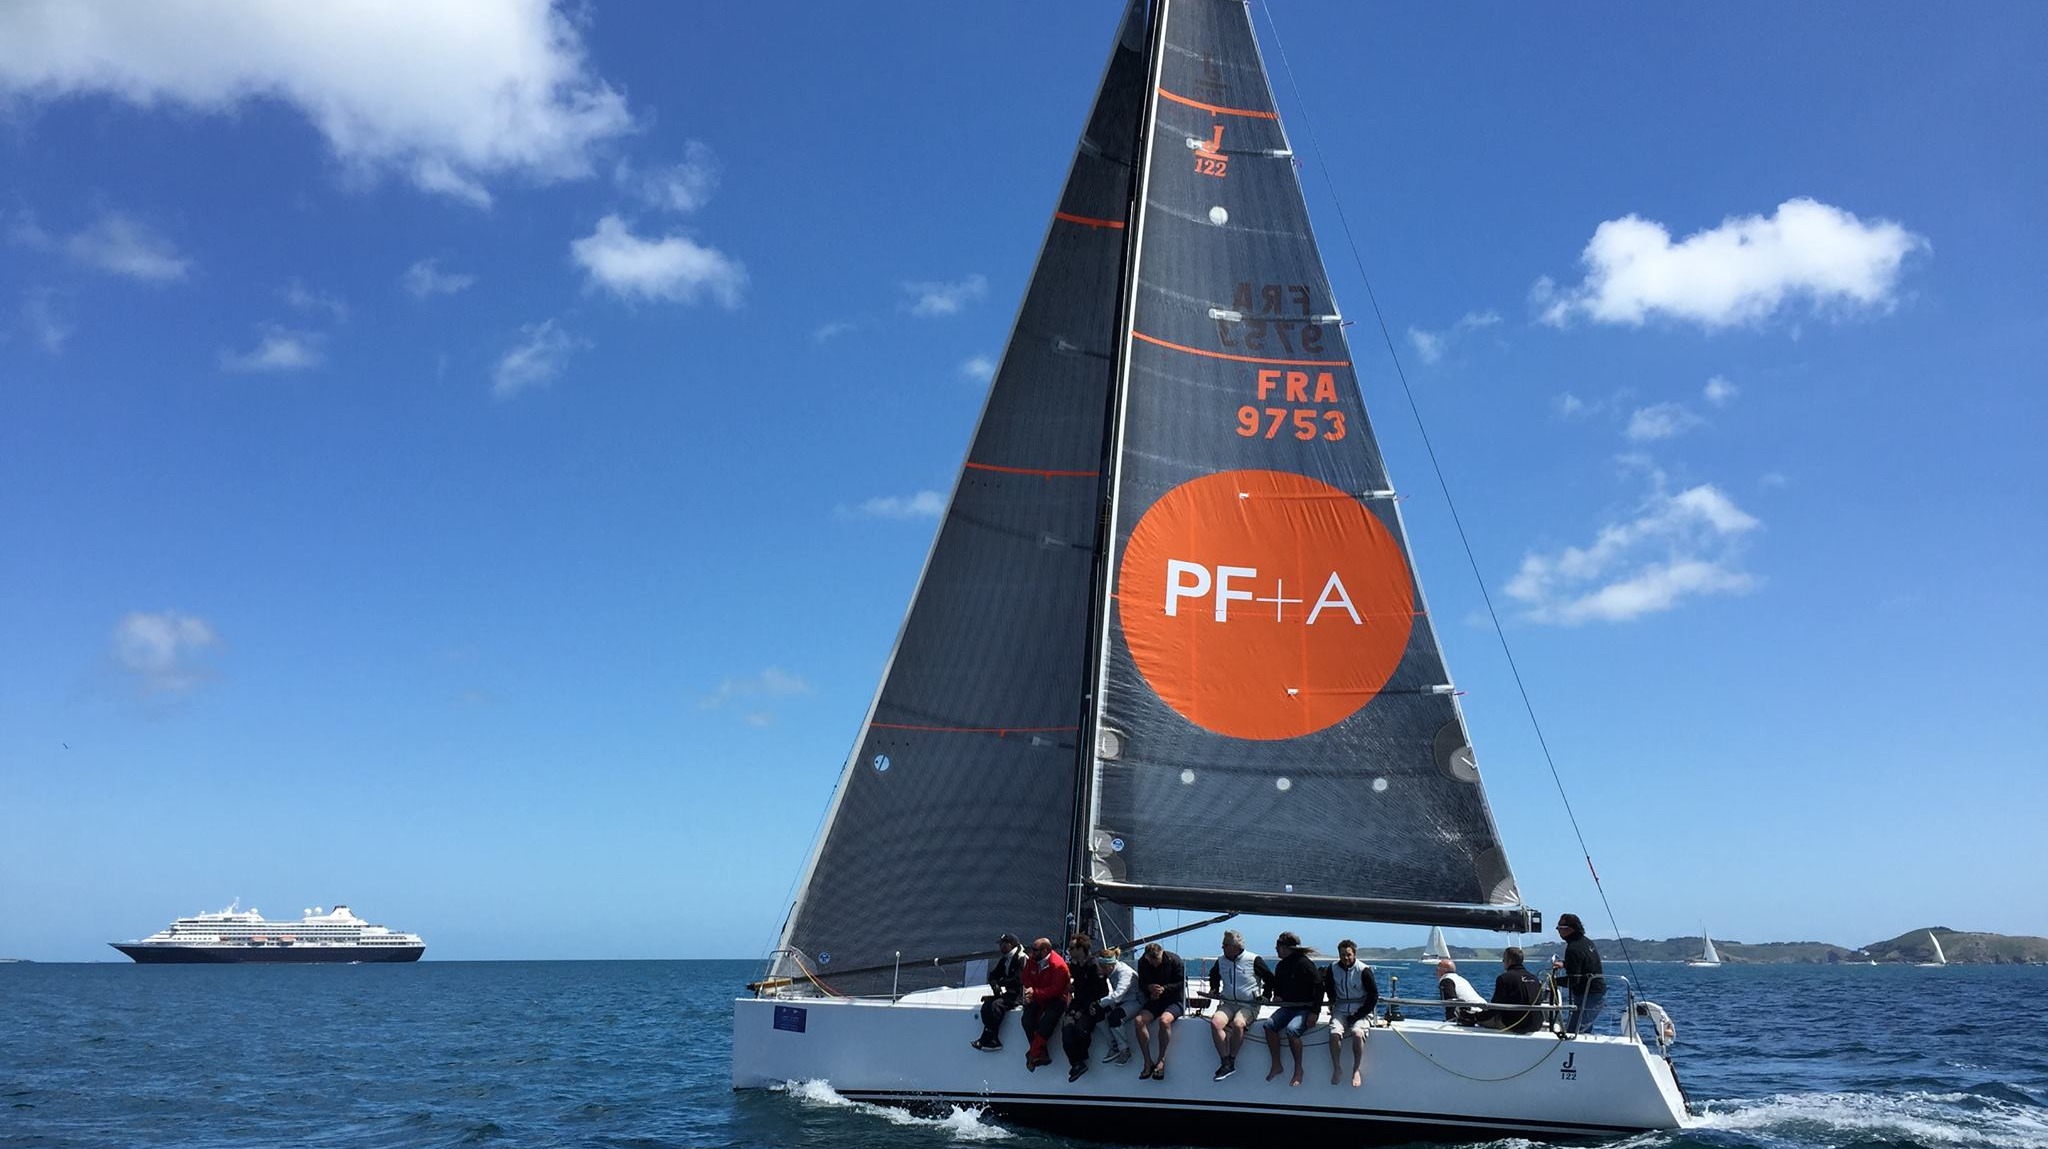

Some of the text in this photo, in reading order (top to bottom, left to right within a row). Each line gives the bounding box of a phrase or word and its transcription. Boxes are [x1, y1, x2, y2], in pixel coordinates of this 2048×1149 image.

[1203, 125, 1225, 153] J
[1194, 158, 1227, 178] 122
[1257, 369, 1338, 403] FRA
[1236, 405, 1346, 442] 9753
[1165, 558, 1363, 625] PF+A
[1563, 1052, 1575, 1068] J
